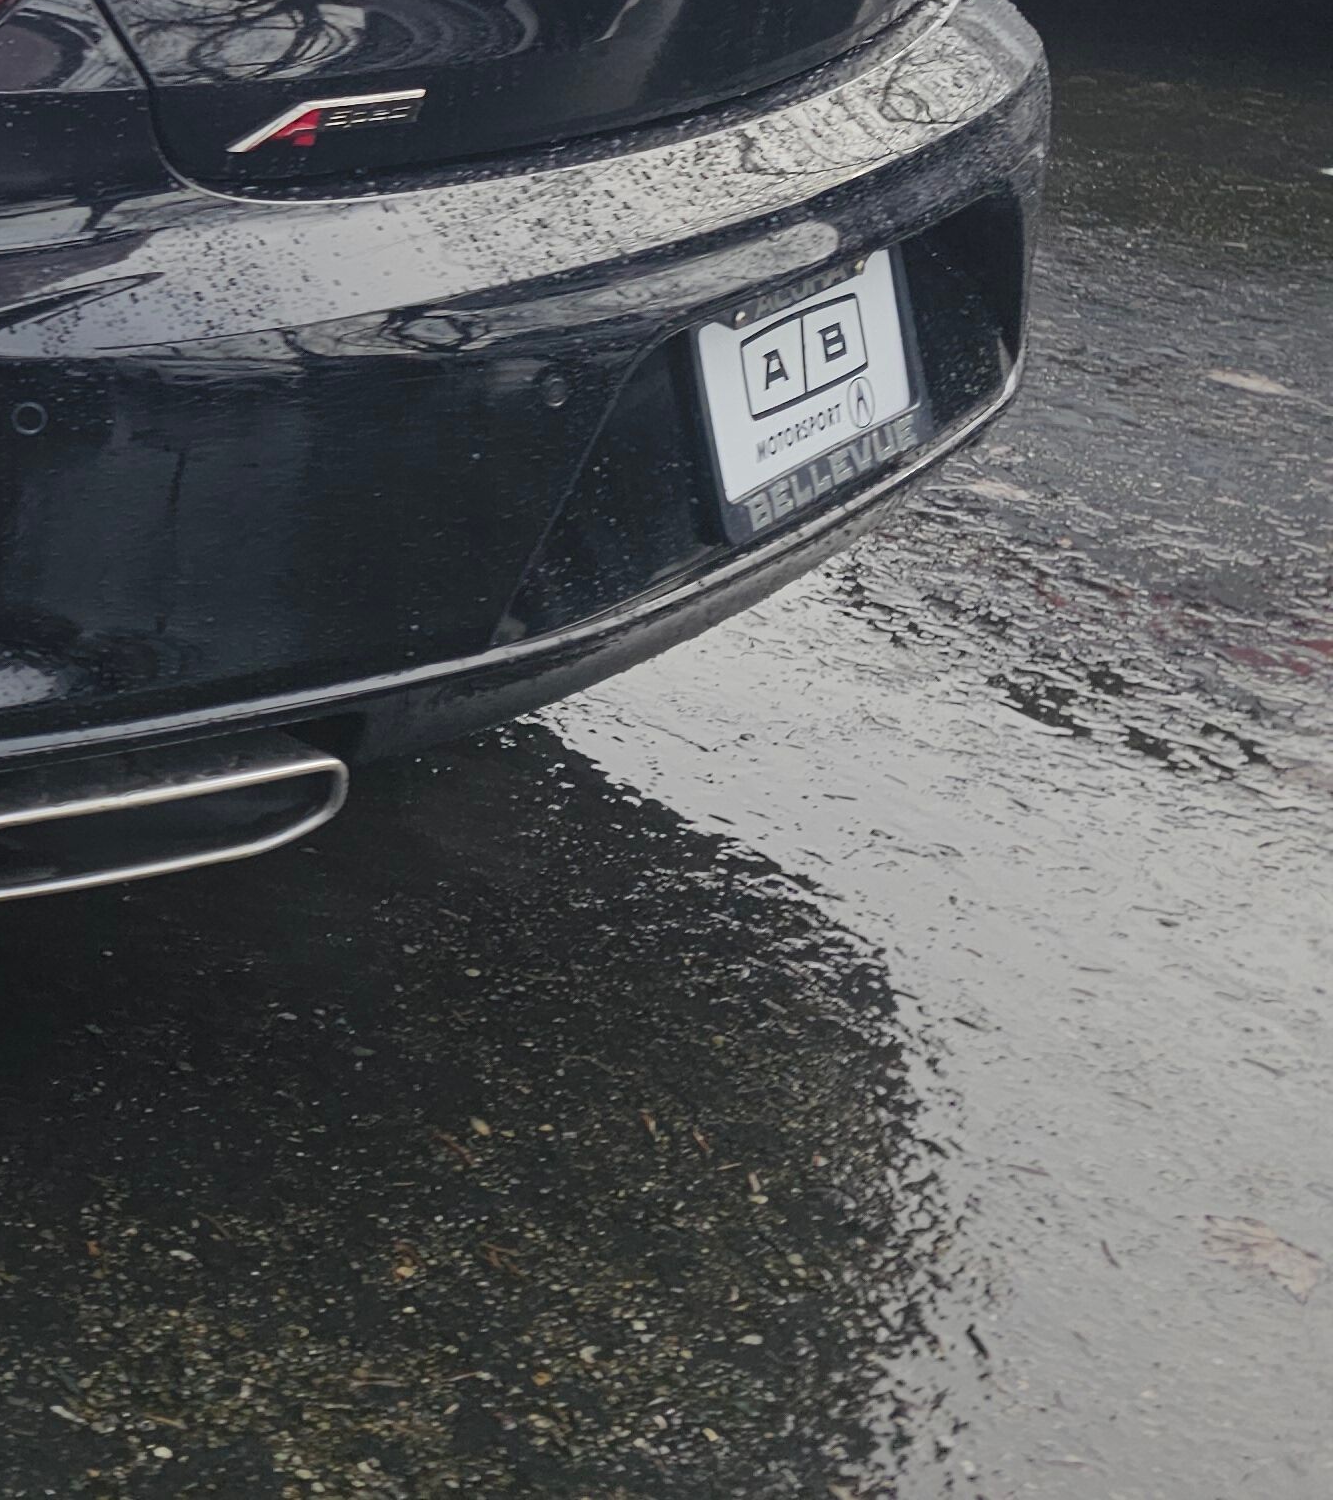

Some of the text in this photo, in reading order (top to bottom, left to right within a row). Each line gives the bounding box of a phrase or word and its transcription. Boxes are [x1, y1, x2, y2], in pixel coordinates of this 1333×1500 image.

[754, 265, 849, 320] ACURA
[762, 321, 848, 391] A B
[755, 402, 843, 464] MOTORSPORT
[744, 413, 919, 533] BELLEVUE
